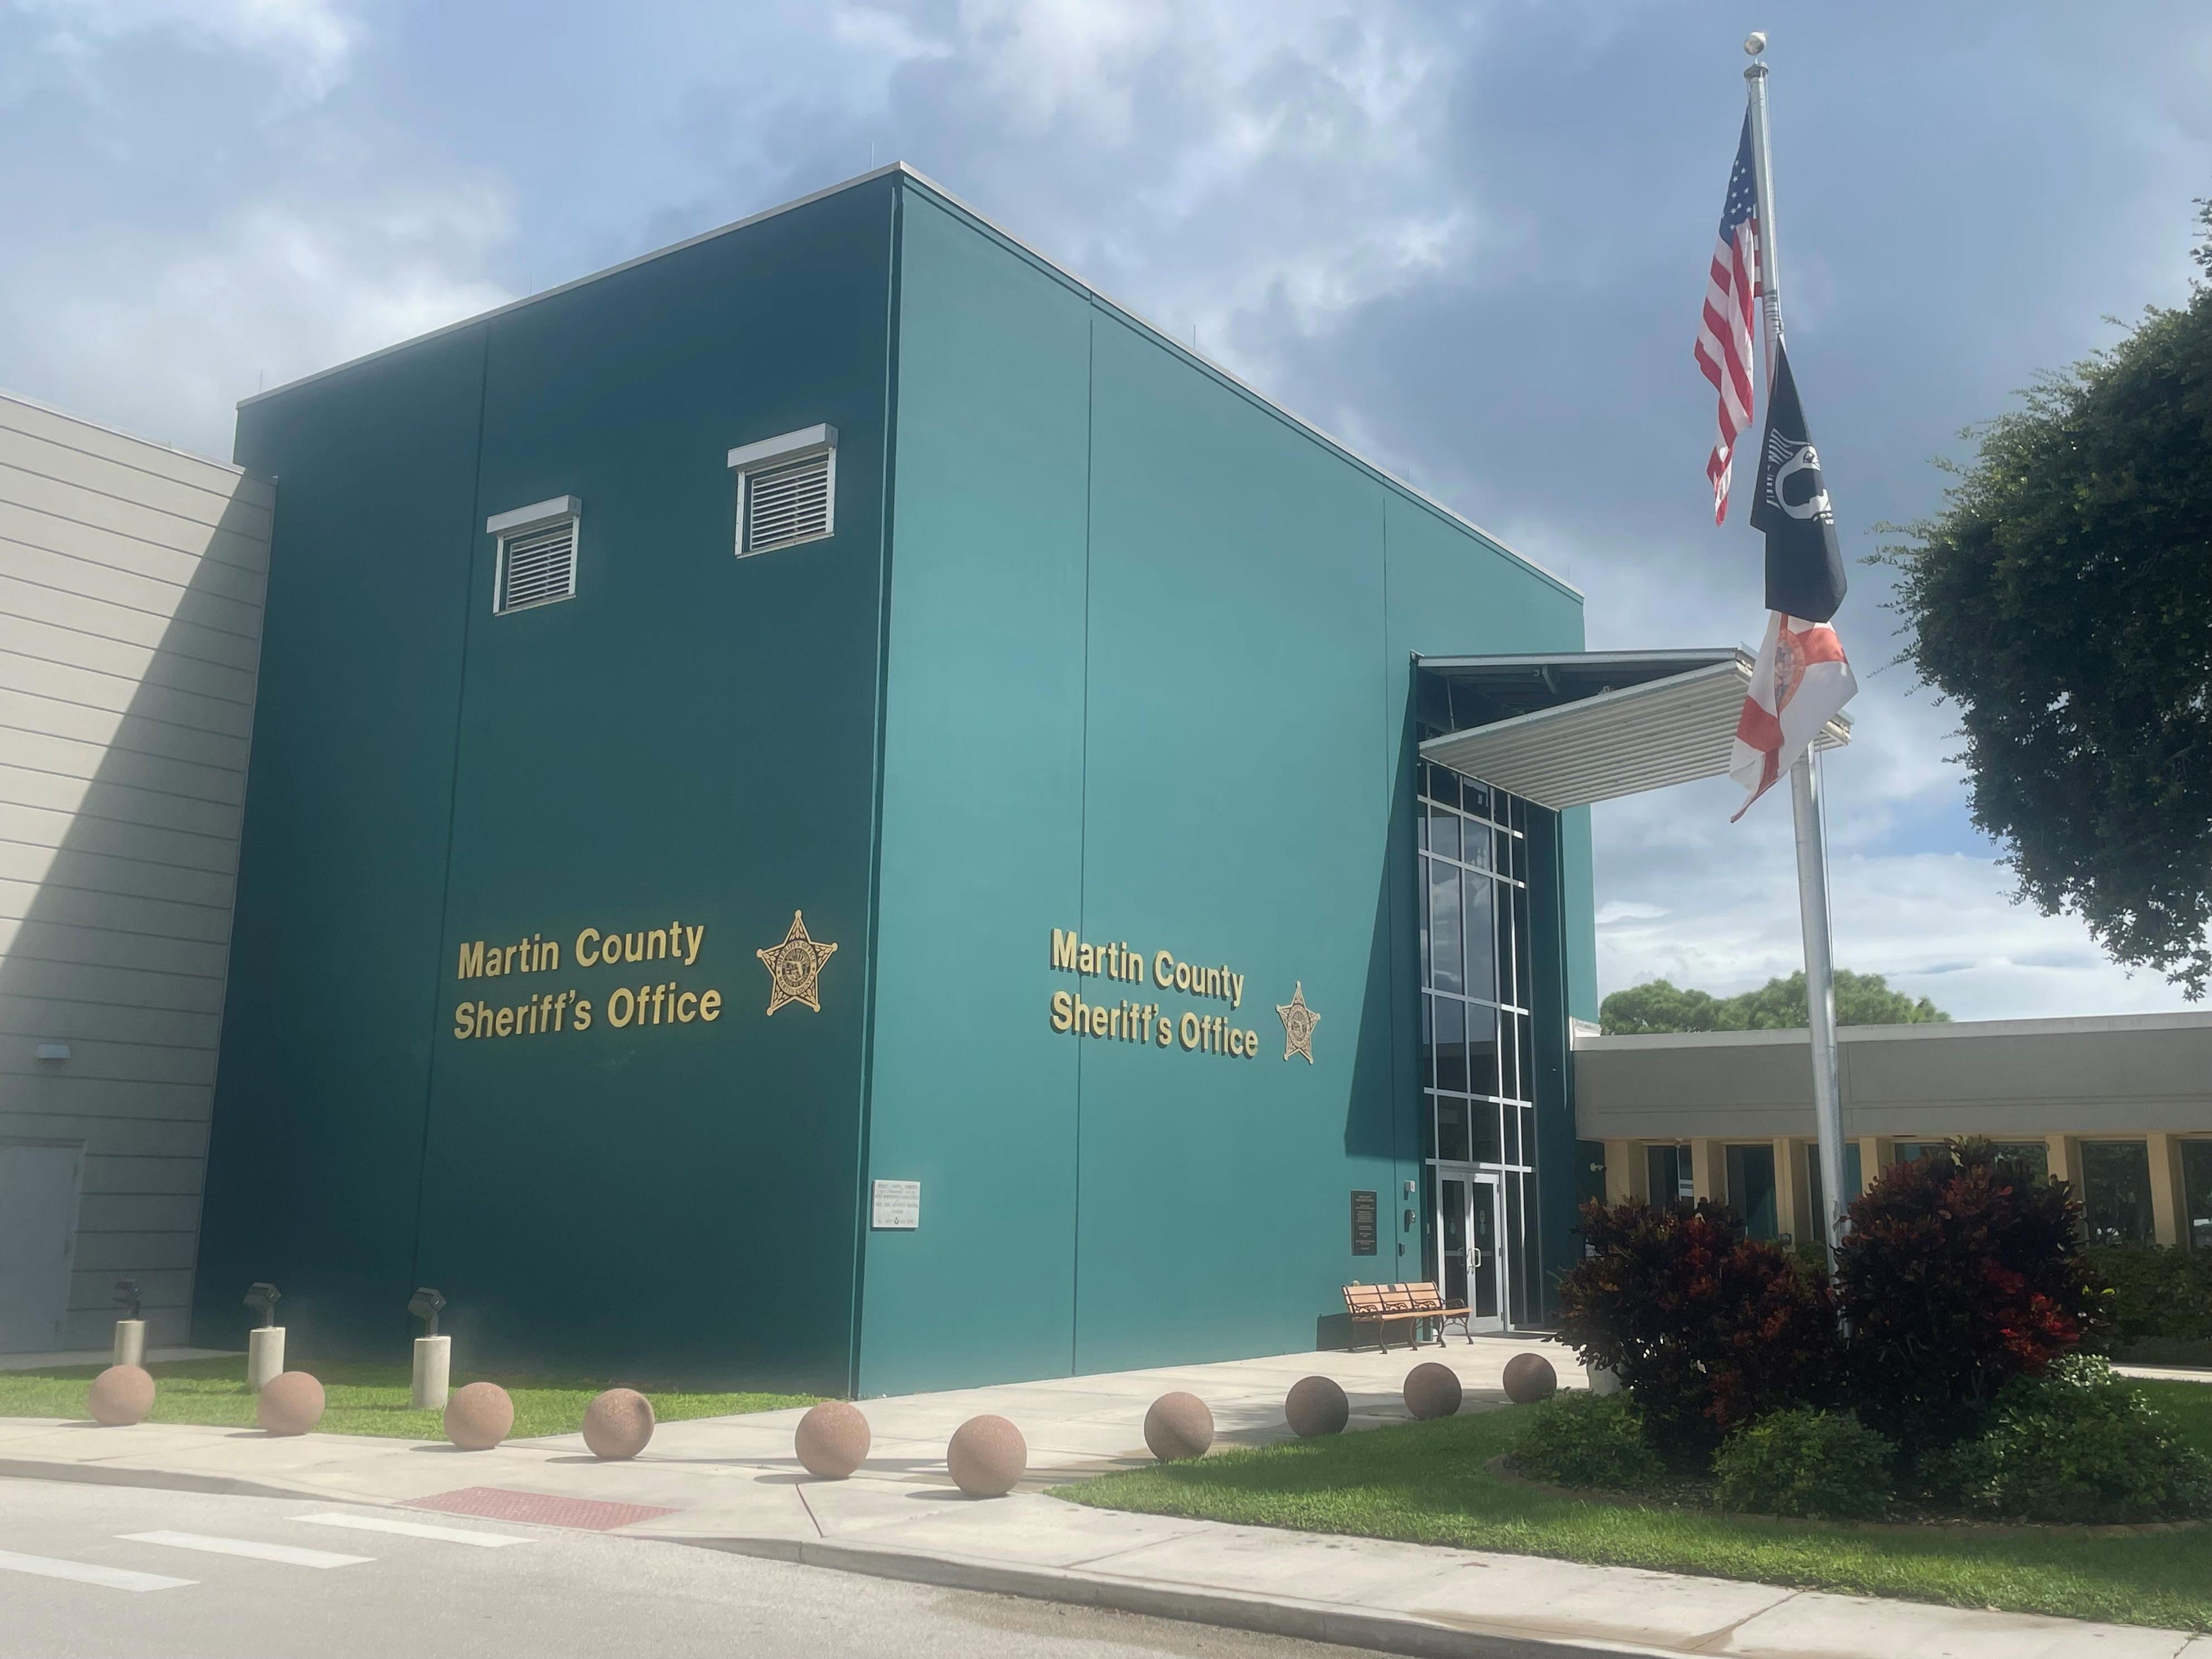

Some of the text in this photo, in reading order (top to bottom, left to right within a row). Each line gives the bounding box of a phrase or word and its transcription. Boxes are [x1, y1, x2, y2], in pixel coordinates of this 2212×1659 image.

[457, 921, 705, 980] Martin County
[1052, 928, 1245, 1007] Martin County
[454, 982, 722, 1040] Sheriff's Office
[1052, 991, 1173, 1045] Sheriff's
[1181, 1011, 1259, 1057] Office
